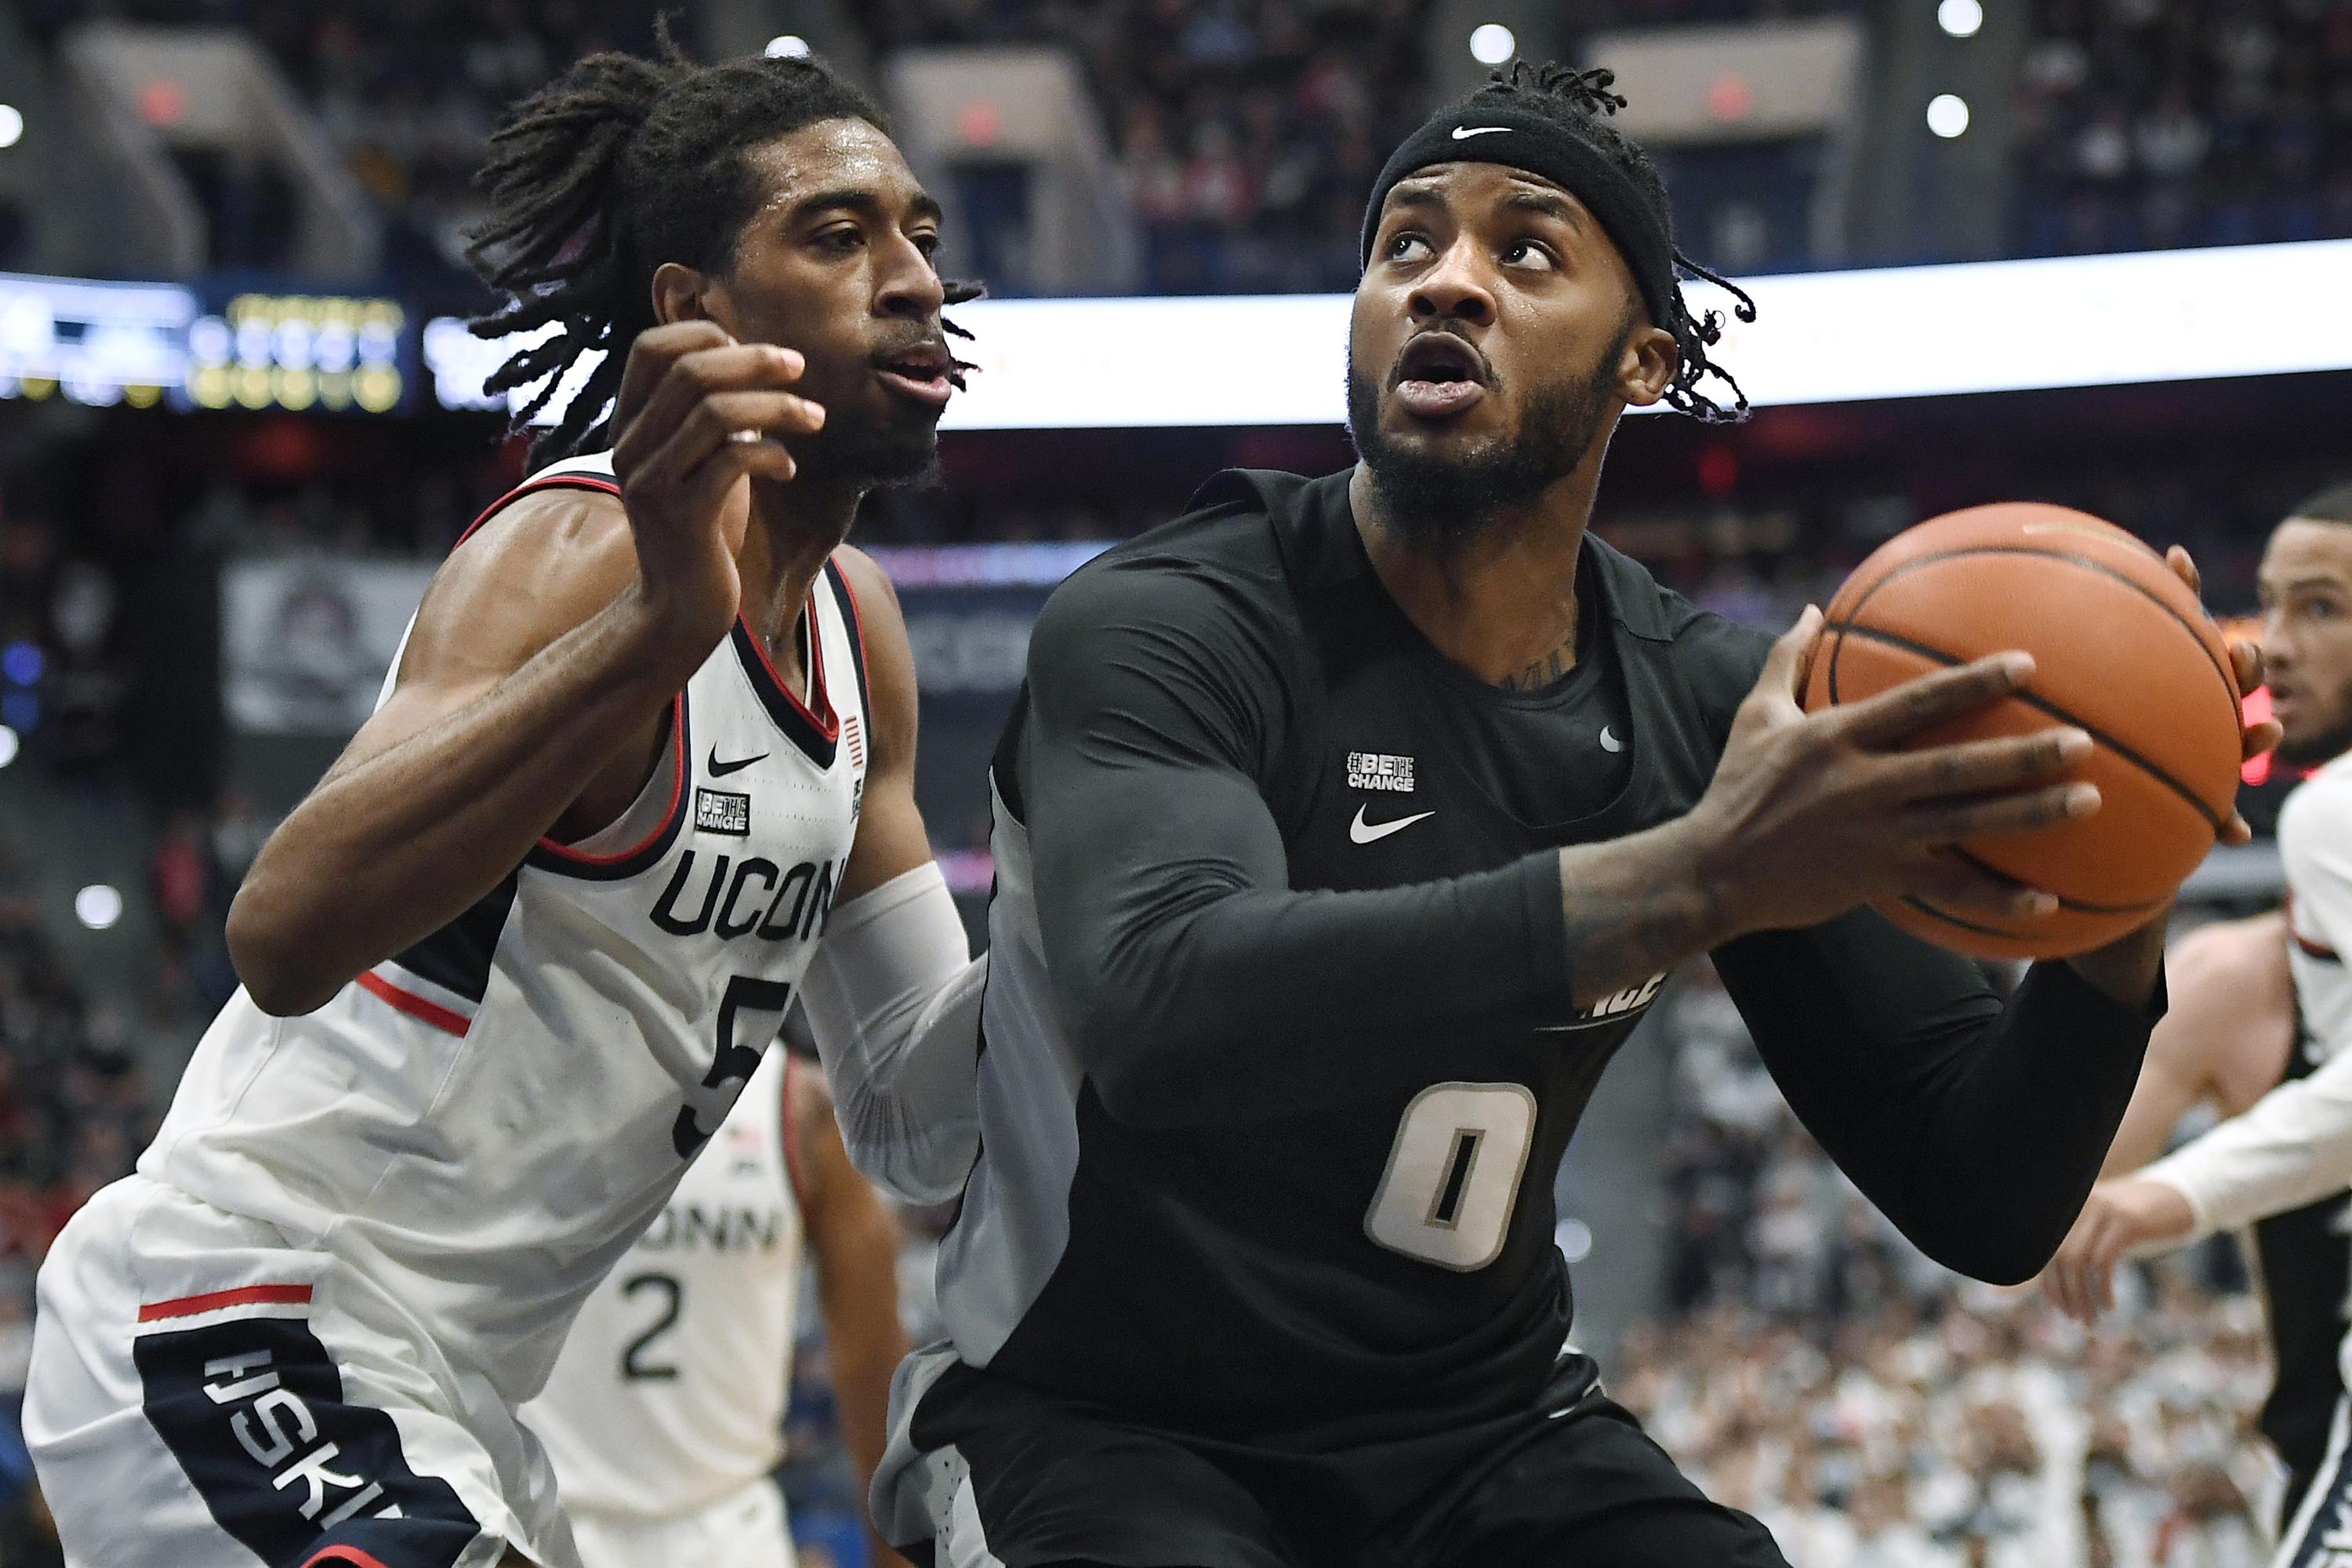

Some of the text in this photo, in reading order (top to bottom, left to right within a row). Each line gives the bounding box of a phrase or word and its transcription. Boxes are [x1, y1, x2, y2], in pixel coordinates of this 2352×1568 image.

[1348, 773, 1415, 792] CHANGE
[671, 975, 791, 1160] 5
[1363, 1080, 1537, 1273] 0
[622, 1270, 681, 1380] 2
